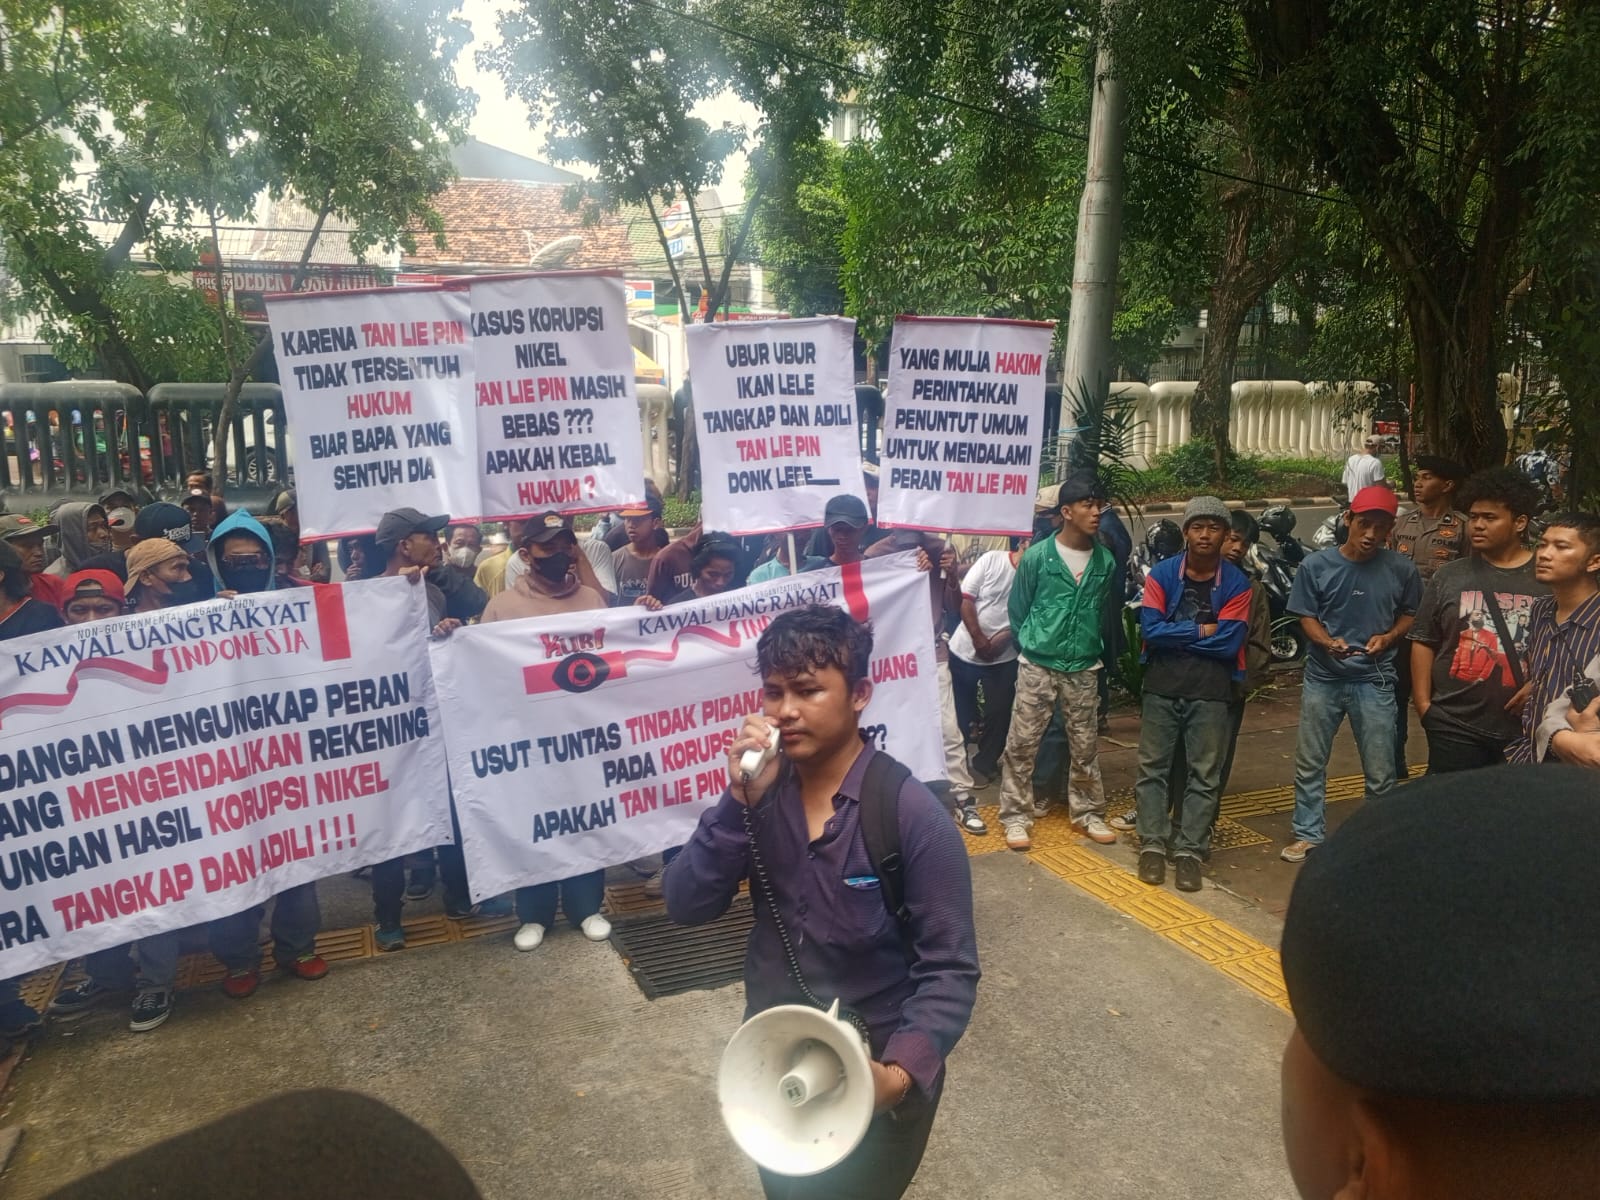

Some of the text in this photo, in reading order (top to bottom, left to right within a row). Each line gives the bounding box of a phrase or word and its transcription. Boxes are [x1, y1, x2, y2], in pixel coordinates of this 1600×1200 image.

[528, 307, 604, 333] KORUPSI
[281, 321, 465, 356] KARENA TAN LIE PIN
[515, 342, 567, 369] NIKEL
[726, 342, 816, 368] UBUR UBUR
[900, 348, 1042, 376] YANG MULIA HAKIM
[293, 355, 461, 391] TIDAK TERSENTUH
[737, 373, 815, 399] IKAN LELE
[347, 391, 413, 419] HUKUM
[506, 379, 535, 404] LIE
[537, 377, 568, 401] PIN
[570, 375, 627, 400] MASIH
[912, 379, 1018, 405] PERINTAHKAN
[502, 408, 594, 439] BEBAS ???
[703, 404, 852, 434] TANGKAP DAN ADILI
[896, 408, 1028, 436] PENUNTUT UMUM
[310, 421, 452, 459] BIAR BAPA YANG
[736, 435, 821, 462] TAN LIE PIN
[886, 438, 1032, 466] UNTUK MENDALAMI
[334, 457, 436, 490] SENTUH DIA
[486, 442, 616, 475] APAKAH KEBAL
[517, 475, 596, 506] HUKUM ?
[728, 468, 773, 494] DONK
[891, 467, 1028, 496] PERAN TAN LIE PIN
[77, 599, 256, 640] NON-GOVERNMENTAL ORGANIZATION
[637, 608, 711, 637] KAWAL
[715, 598, 768, 621] UANG
[770, 582, 840, 612] RAKYAT
[14, 601, 311, 677] KAWAL UANG RAKYAT
[167, 628, 310, 673] INDONESIA
[872, 652, 918, 684] UANG
[129, 687, 317, 760] MENGUNGKAP
[325, 671, 410, 717] PERAN
[471, 739, 531, 779] USUT
[537, 722, 622, 765] TUNTAS
[625, 703, 696, 746] TINDAK
[66, 731, 304, 822] MENGENDALIKAN
[308, 706, 430, 763] REKENING
[602, 752, 657, 788] PADA
[114, 806, 202, 860] HASIL
[205, 775, 307, 836] KORUPSI
[314, 761, 389, 806] NIKEL
[533, 766, 727, 843] APAKAH TAN LIE PIN
[0, 905, 50, 951] RA
[53, 863, 194, 932] TANGKAP
[200, 845, 258, 894] DAN
